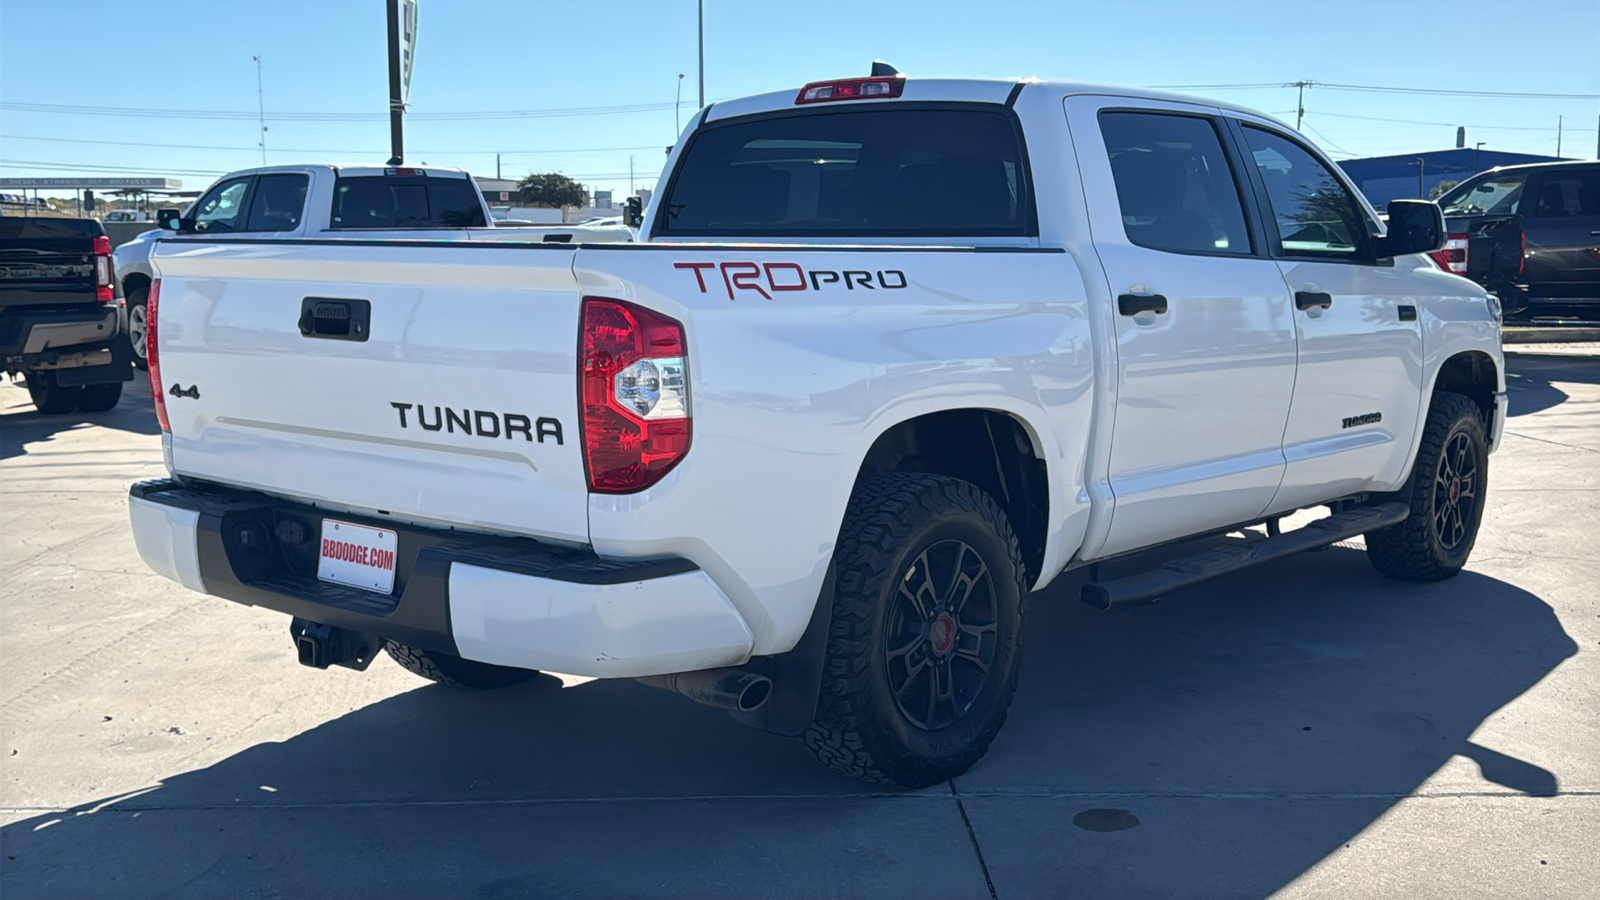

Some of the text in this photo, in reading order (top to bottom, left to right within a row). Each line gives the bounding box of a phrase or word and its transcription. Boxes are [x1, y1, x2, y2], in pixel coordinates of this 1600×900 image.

[673, 262, 908, 300] TRD PRO
[317, 306, 346, 317] TOYOTA
[389, 401, 564, 446] TUNDRA
[1341, 411, 1383, 429] TUNDRA
[322, 538, 394, 571] BBDODGE.COM
